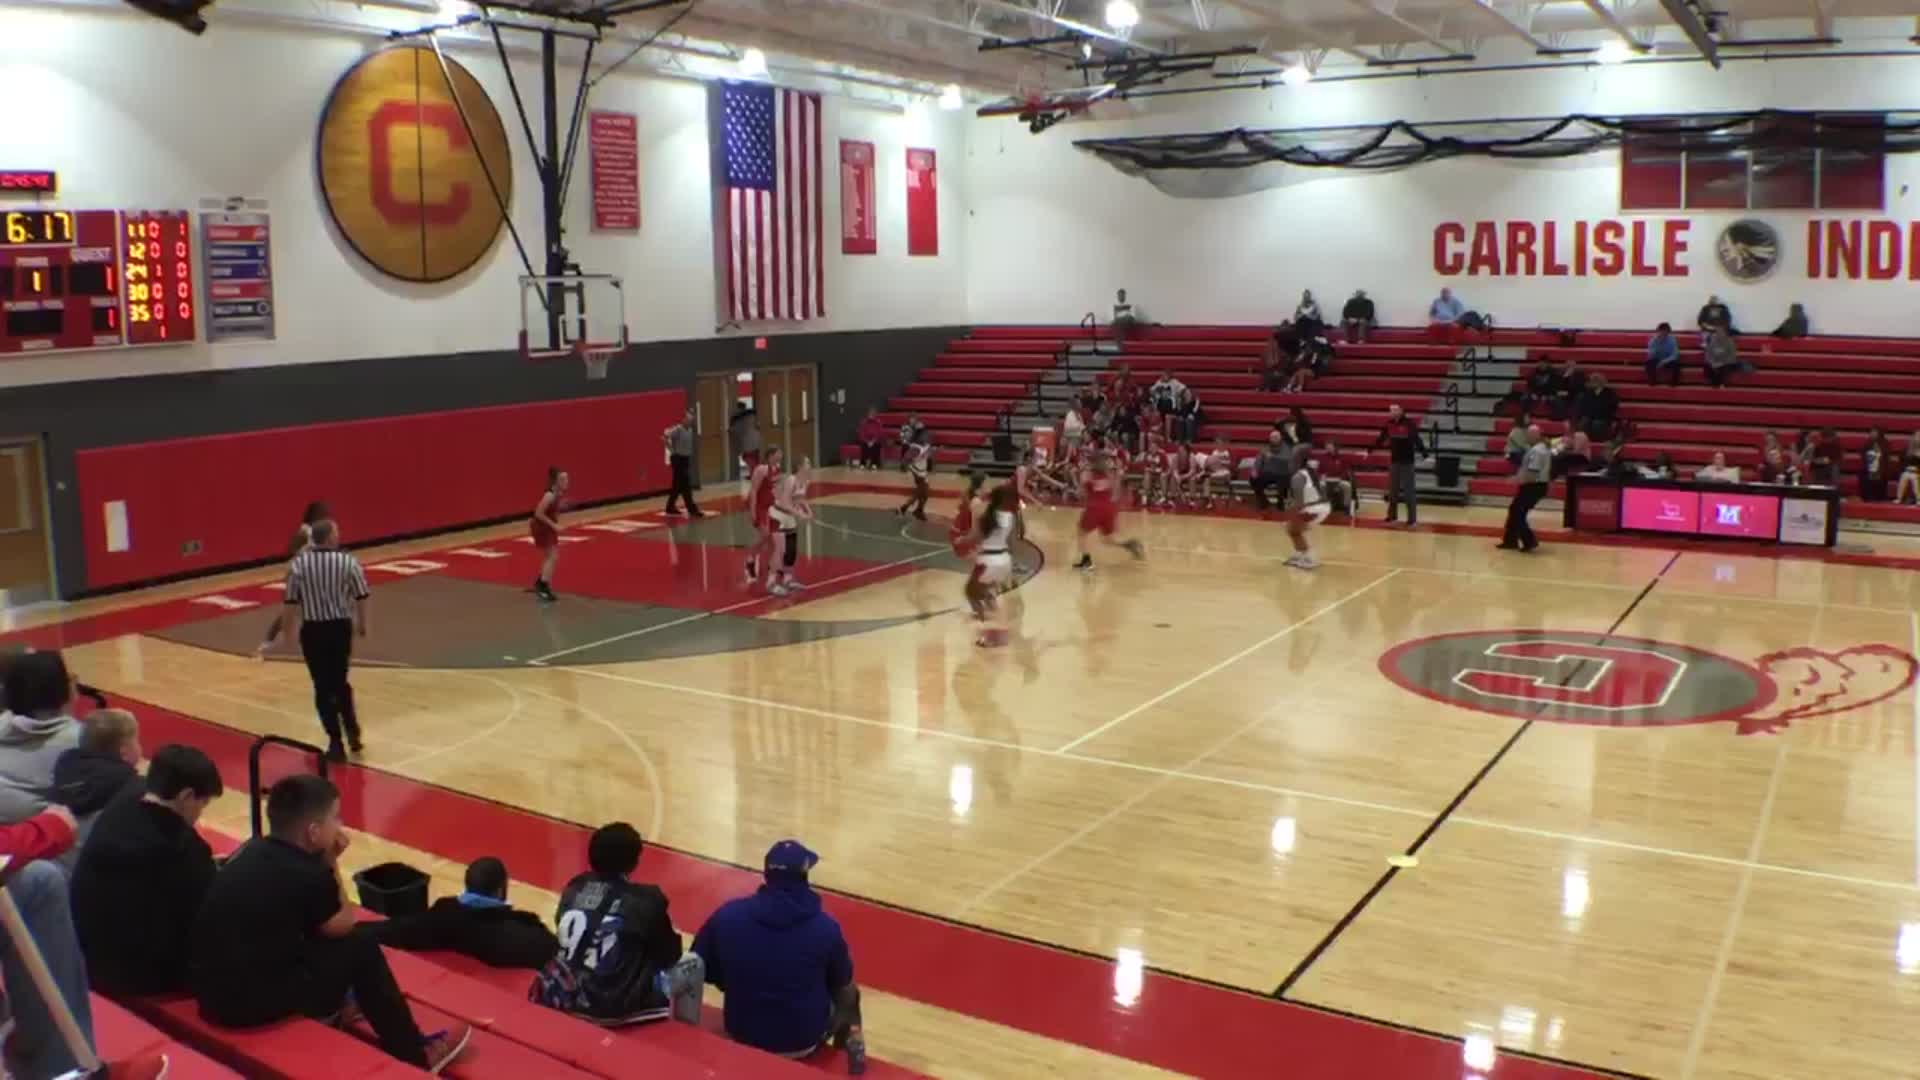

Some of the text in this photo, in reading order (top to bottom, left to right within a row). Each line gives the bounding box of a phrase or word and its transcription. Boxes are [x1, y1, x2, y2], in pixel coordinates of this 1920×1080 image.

[367, 99, 472, 226] C
[6, 212, 72, 243] 6:17
[128, 224, 146, 237] 11
[149, 221, 159, 238] 0
[150, 242, 160, 258] 0
[176, 242, 186, 257] 0
[1433, 219, 1690, 276] CARLISLE
[177, 262, 187, 278] 0
[32, 270, 41, 292] 1
[128, 282, 188, 301] 30 0 0
[129, 303, 190, 322] 35 0 0
